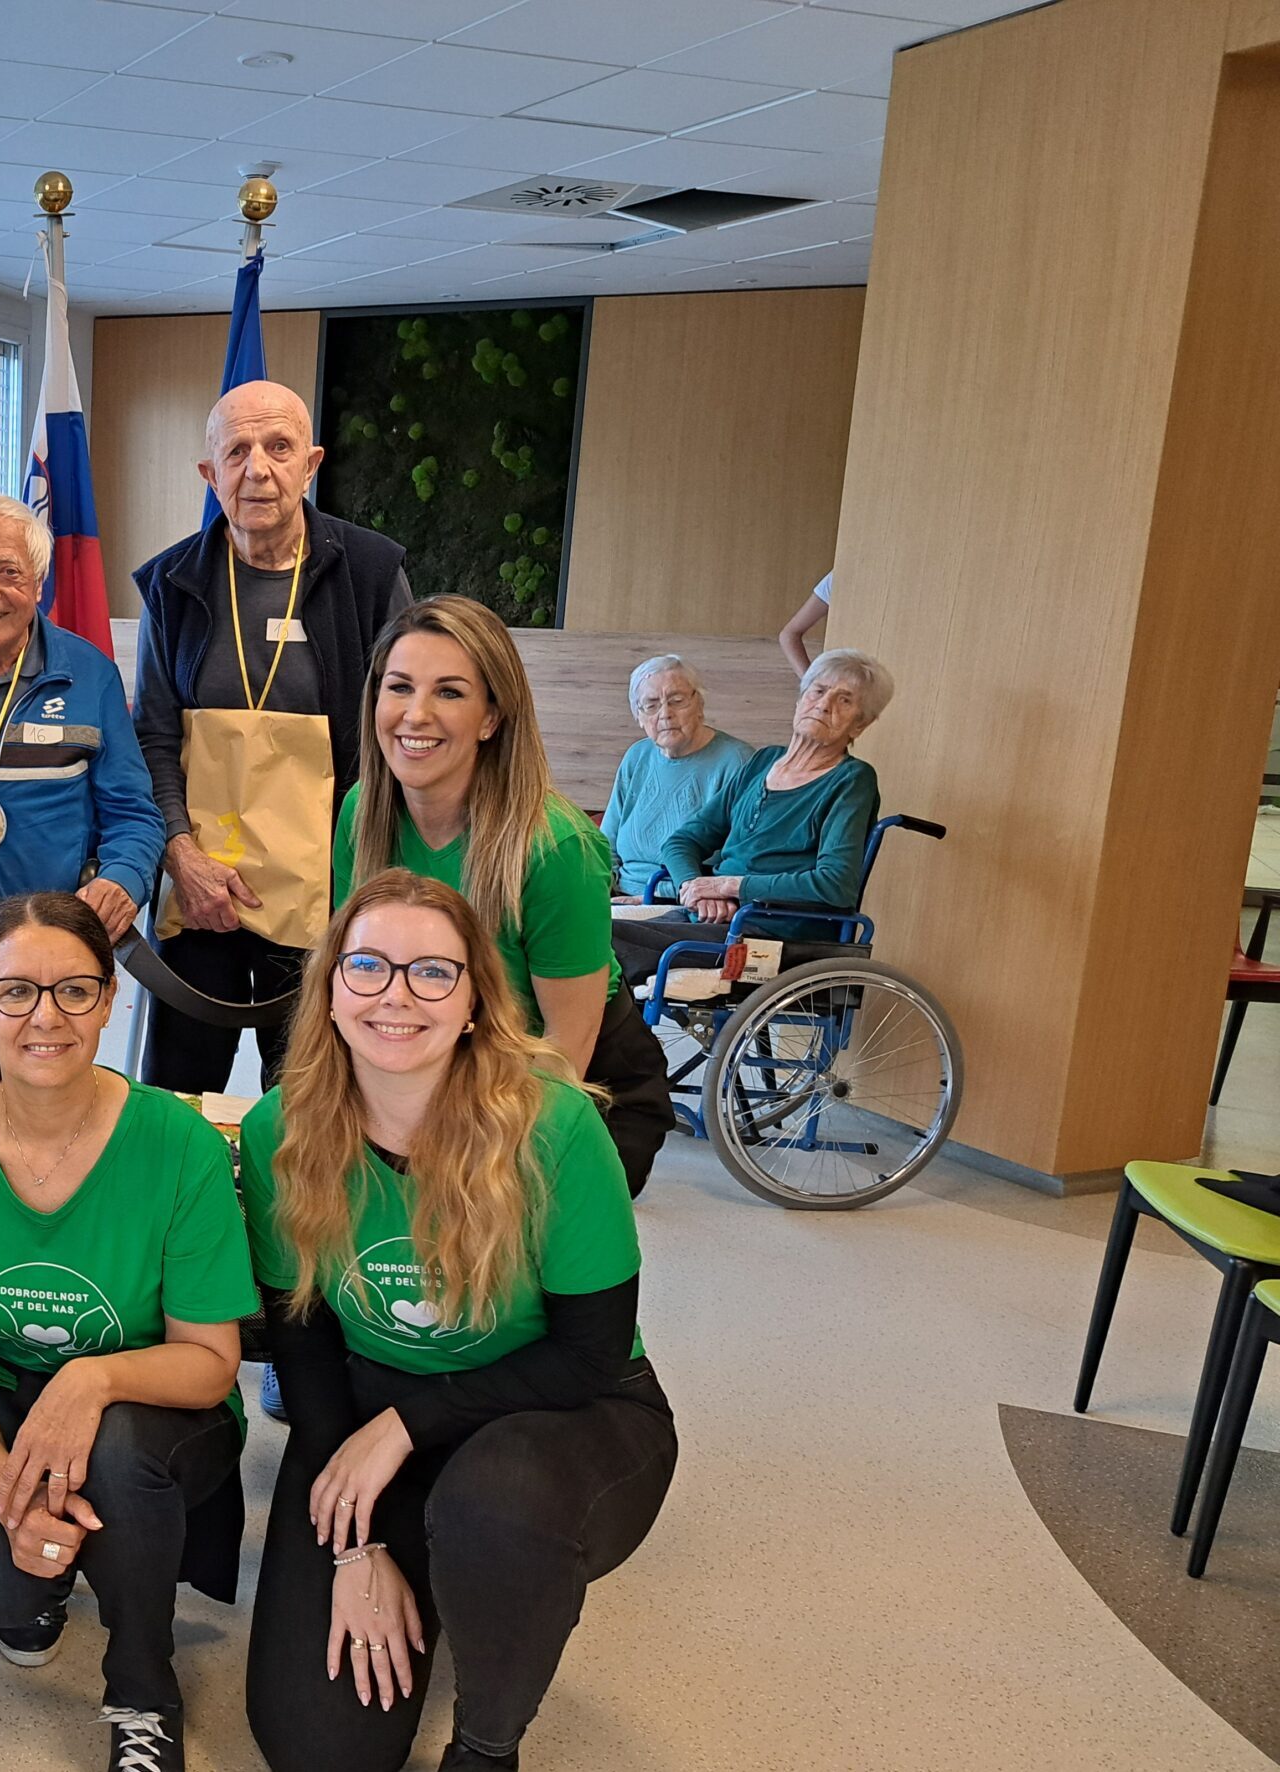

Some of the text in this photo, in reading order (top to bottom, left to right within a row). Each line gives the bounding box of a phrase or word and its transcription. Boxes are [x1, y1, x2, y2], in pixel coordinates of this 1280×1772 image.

[30, 726, 46, 743] 16
[378, 1276, 392, 1286] JE
[395, 1277, 417, 1287] DEL
[0, 1286, 89, 1303] DOBRODELNOST
[10, 1301, 78, 1315] JE DEL NAS.
